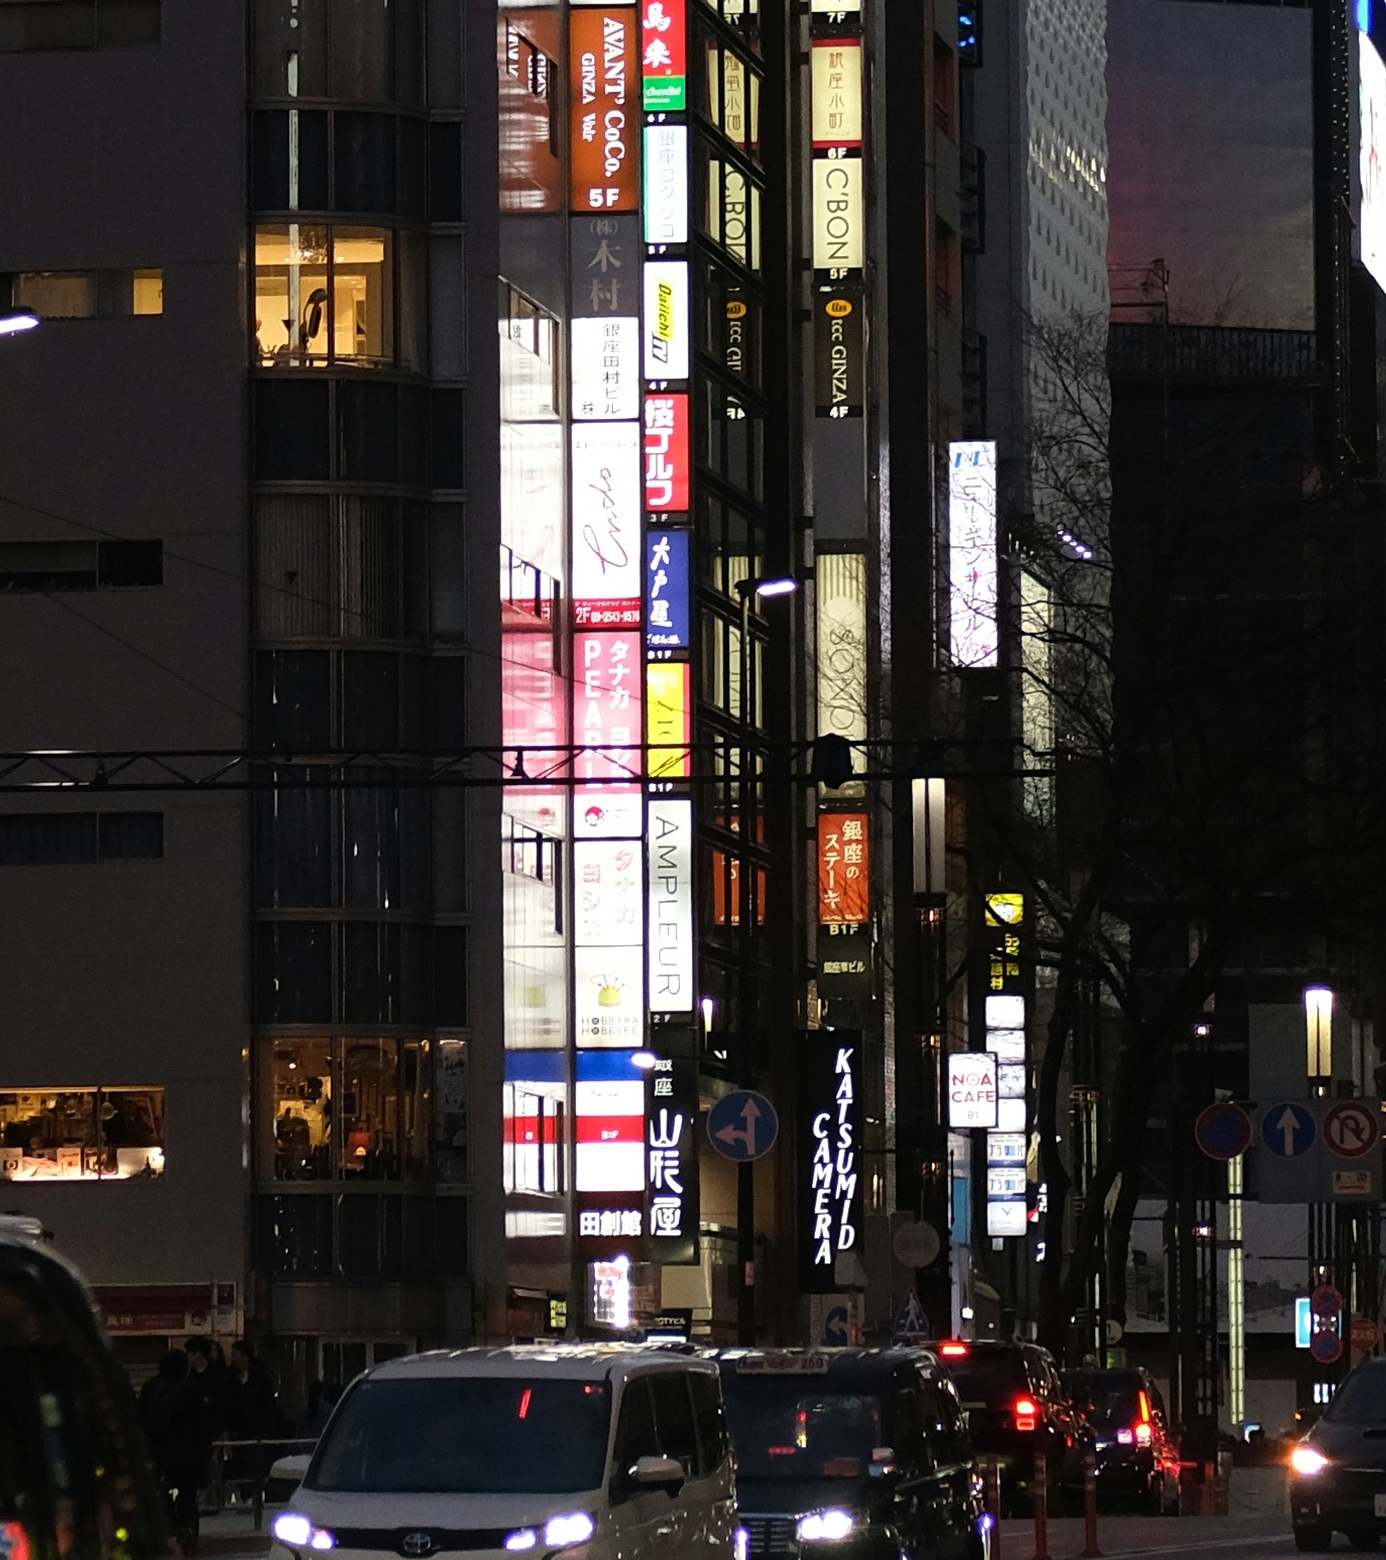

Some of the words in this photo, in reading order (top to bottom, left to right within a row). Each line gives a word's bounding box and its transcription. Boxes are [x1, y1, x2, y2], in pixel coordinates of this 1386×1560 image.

[827, 12, 847, 24] 7F
[581, 52, 596, 105] GINZA
[828, 52, 845, 129] 銀座小町
[827, 147, 848, 159] 6F
[589, 188, 620, 208] 5F
[826, 168, 849, 260] C'BON
[586, 239, 622, 312] 木村
[829, 268, 849, 280] 5F
[602, 323, 621, 415] 銀座田村ビル
[831, 345, 848, 404] GINZA
[829, 406, 849, 418] 4F
[649, 513, 668, 522] 3F
[649, 535, 673, 628] 大戸屋
[609, 639, 631, 710] タナカ
[823, 833, 841, 909] ステーキ
[842, 820, 863, 879] 銀座の
[655, 815, 681, 996] AMPLEUR
[653, 1015, 671, 1024] 2F
[951, 1090, 995, 1103] CAFE
[952, 1073, 993, 1086] NOA
[650, 1108, 683, 1237] 山形屋
[811, 1113, 834, 1265] CAMERA
